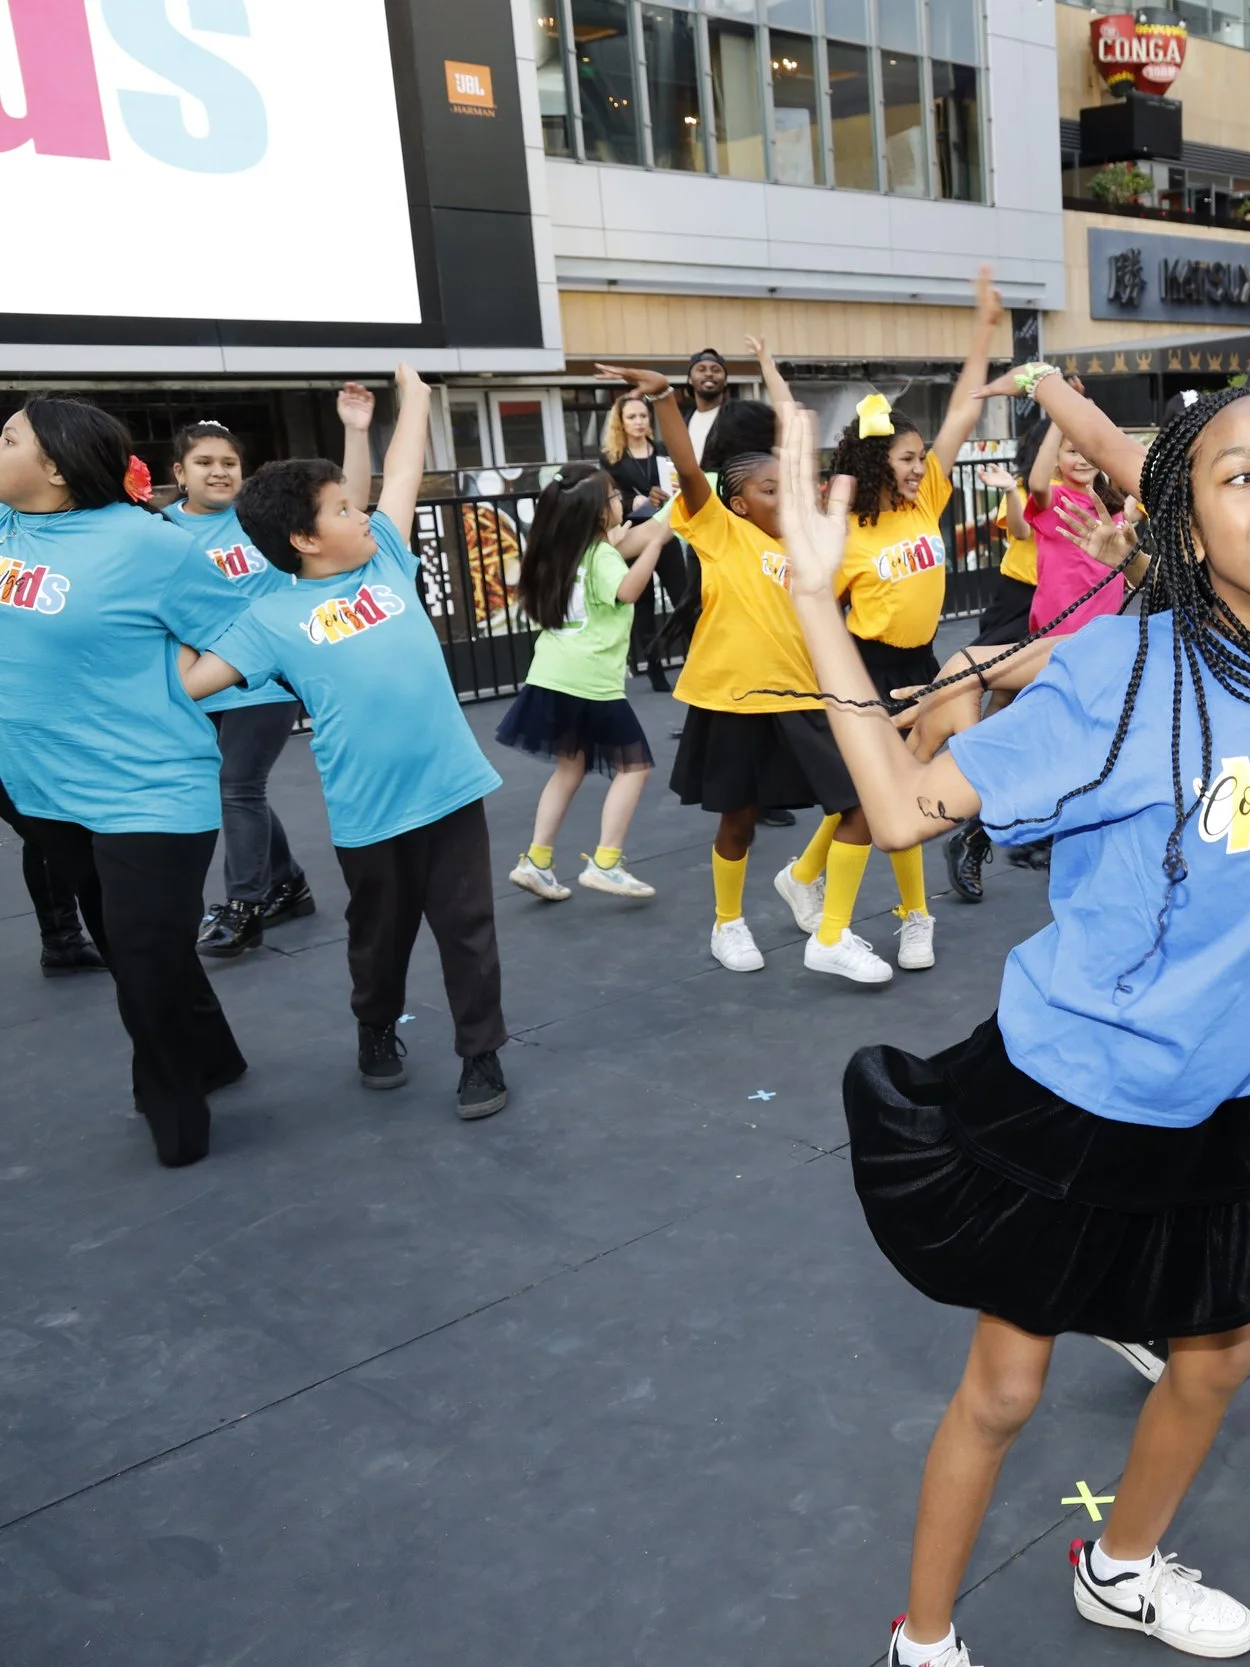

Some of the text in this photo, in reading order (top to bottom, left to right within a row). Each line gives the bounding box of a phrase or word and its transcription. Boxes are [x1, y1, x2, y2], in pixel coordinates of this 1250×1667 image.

[1098, 37, 1182, 63] CONGA
[453, 72, 486, 97] JBL
[882, 534, 945, 583] Kids
[312, 585, 404, 643] Kids
